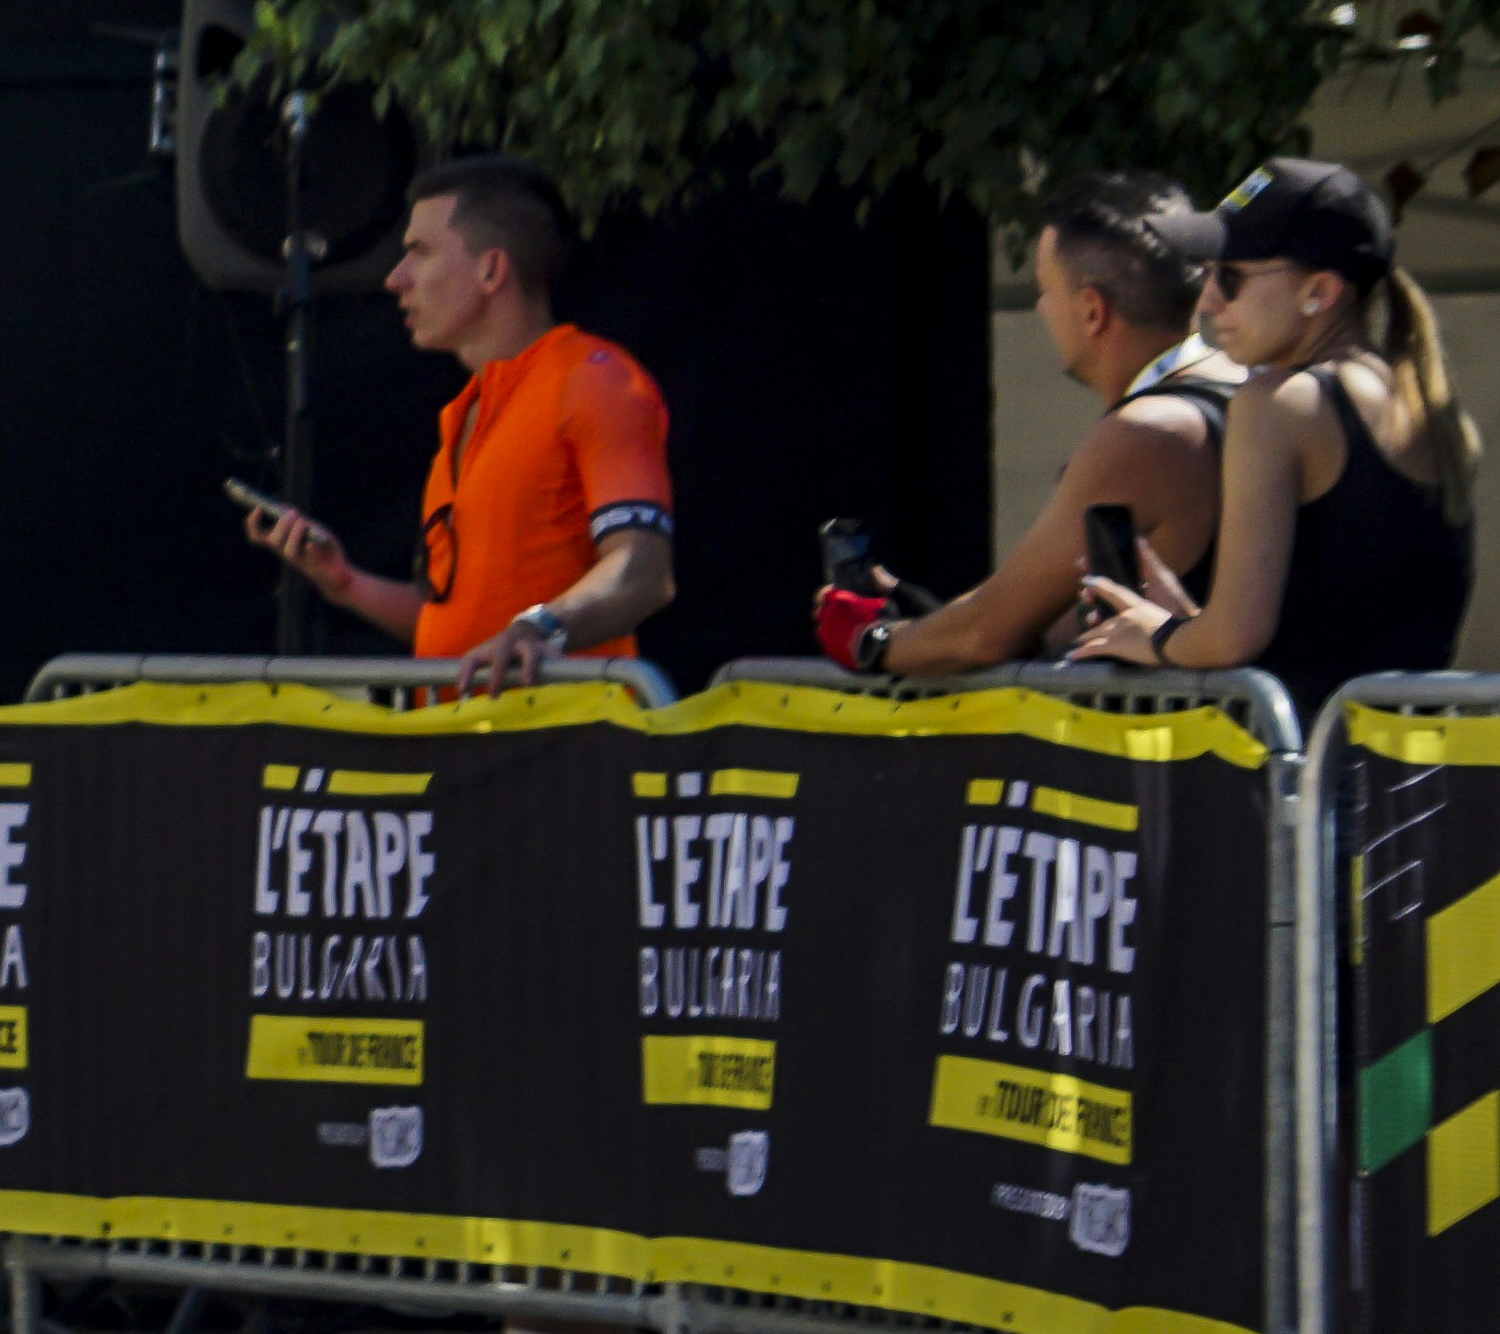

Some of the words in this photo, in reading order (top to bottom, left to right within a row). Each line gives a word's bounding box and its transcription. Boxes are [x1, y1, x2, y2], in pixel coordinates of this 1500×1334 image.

[254, 769, 436, 918] L'ÉTAPE
[950, 780, 1138, 973] L'ÉTAPE
[939, 962, 1135, 1069] BULGARIA
